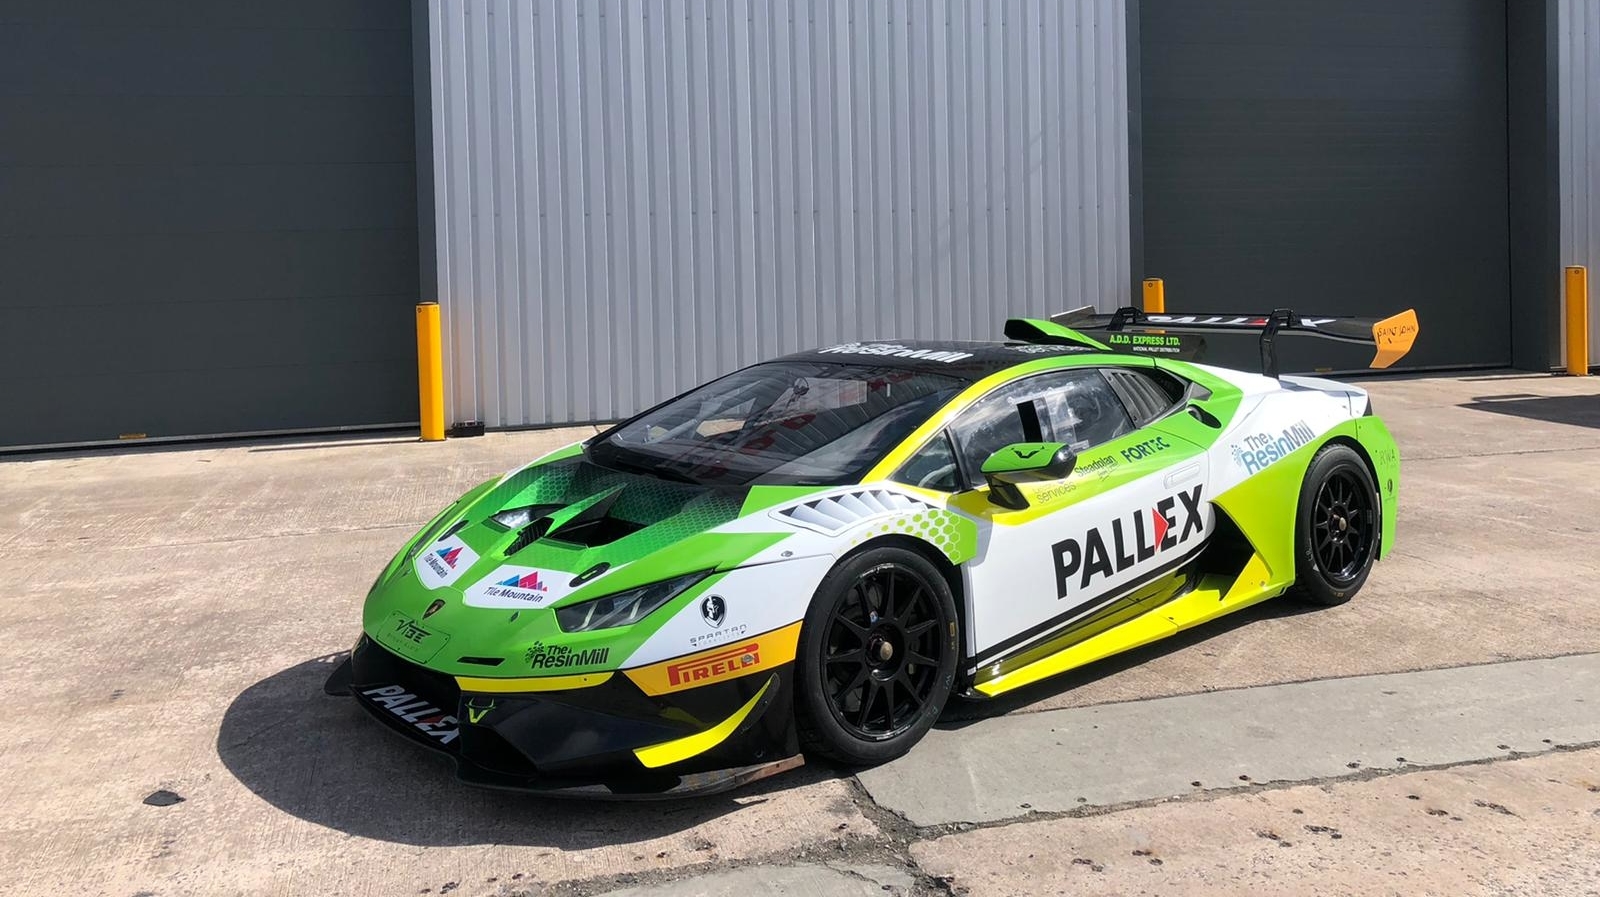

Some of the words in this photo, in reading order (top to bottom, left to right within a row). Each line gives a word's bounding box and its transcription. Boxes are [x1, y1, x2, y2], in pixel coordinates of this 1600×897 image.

[1147, 315, 1336, 329] PALLX
[1109, 334, 1131, 344] A.D.D.
[1132, 335, 1165, 346] EXPRESS
[1166, 337, 1181, 346] LTD.
[1241, 419, 1316, 475] ResinMill
[1244, 432, 1269, 451] The
[1074, 454, 1117, 477] Steadplan
[1051, 484, 1204, 600] PALLEX
[484, 586, 499, 597] Tile
[499, 588, 543, 602] Mountain
[532, 648, 610, 669] ResinMill
[548, 645, 567, 655] The
